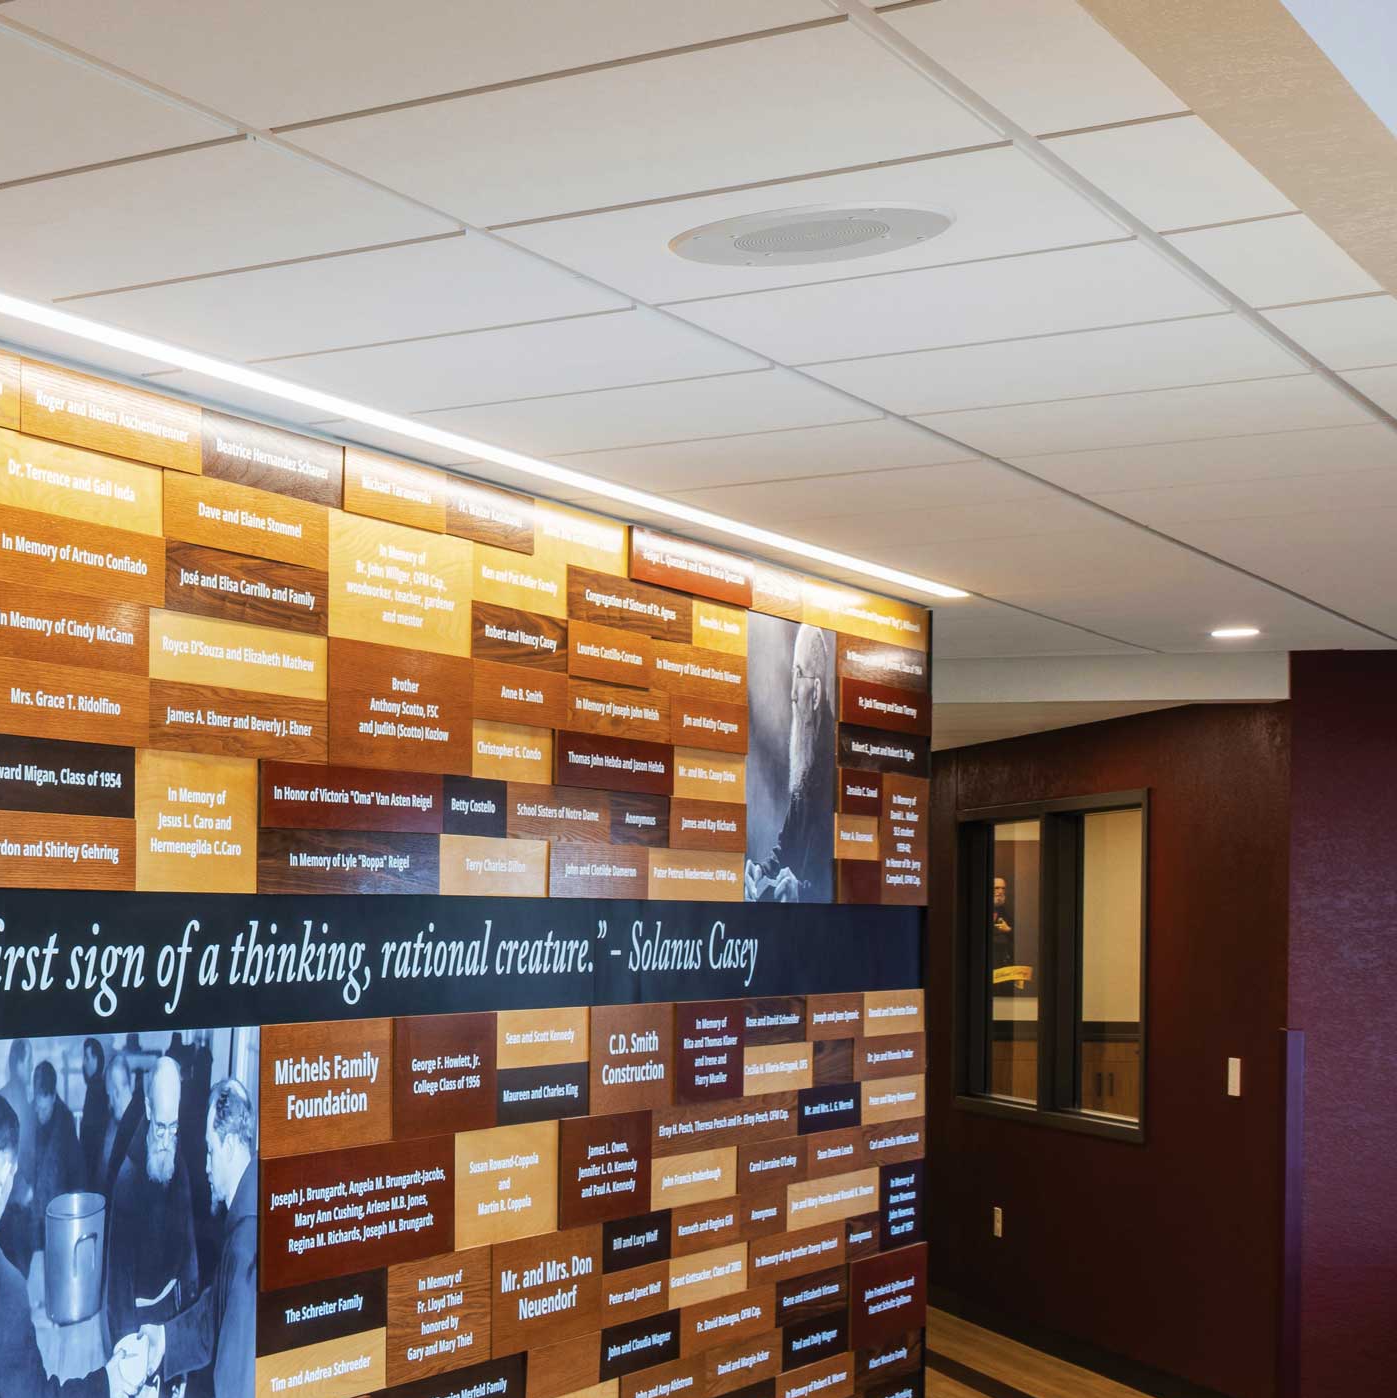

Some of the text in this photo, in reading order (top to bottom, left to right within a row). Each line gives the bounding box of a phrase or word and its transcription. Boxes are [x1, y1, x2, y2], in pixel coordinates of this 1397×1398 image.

[485, 624, 556, 653] Robert and Nancy Casey
[391, 677, 419, 693] Brother
[500, 685, 543, 704] Anne B. Smith
[369, 697, 439, 718] Anthony Scotto, FSC
[23, 764, 58, 786] Migan,
[59, 767, 85, 786] Class
[86, 770, 98, 786] of
[99, 771, 121, 788] 1954
[451, 797, 495, 815] Betty Costello
[66, 923, 147, 1017] sign
[157, 919, 201, 1014] of
[198, 942, 220, 986] a
[230, 919, 373, 1005] thinking,
[381, 919, 490, 980] rational
[628, 919, 703, 972] Solanus
[709, 920, 759, 987] Casey
[608, 1030, 658, 1055] C.D. Smith
[275, 1051, 379, 1085] Michels Family
[601, 1059, 664, 1085] Construction
[287, 1087, 367, 1120] Foundation
[501, 1255, 592, 1293] Mr. and Mrs. Don
[284, 1293, 363, 1324] The Schreiter Family
[518, 1285, 578, 1321] Neuendorf
